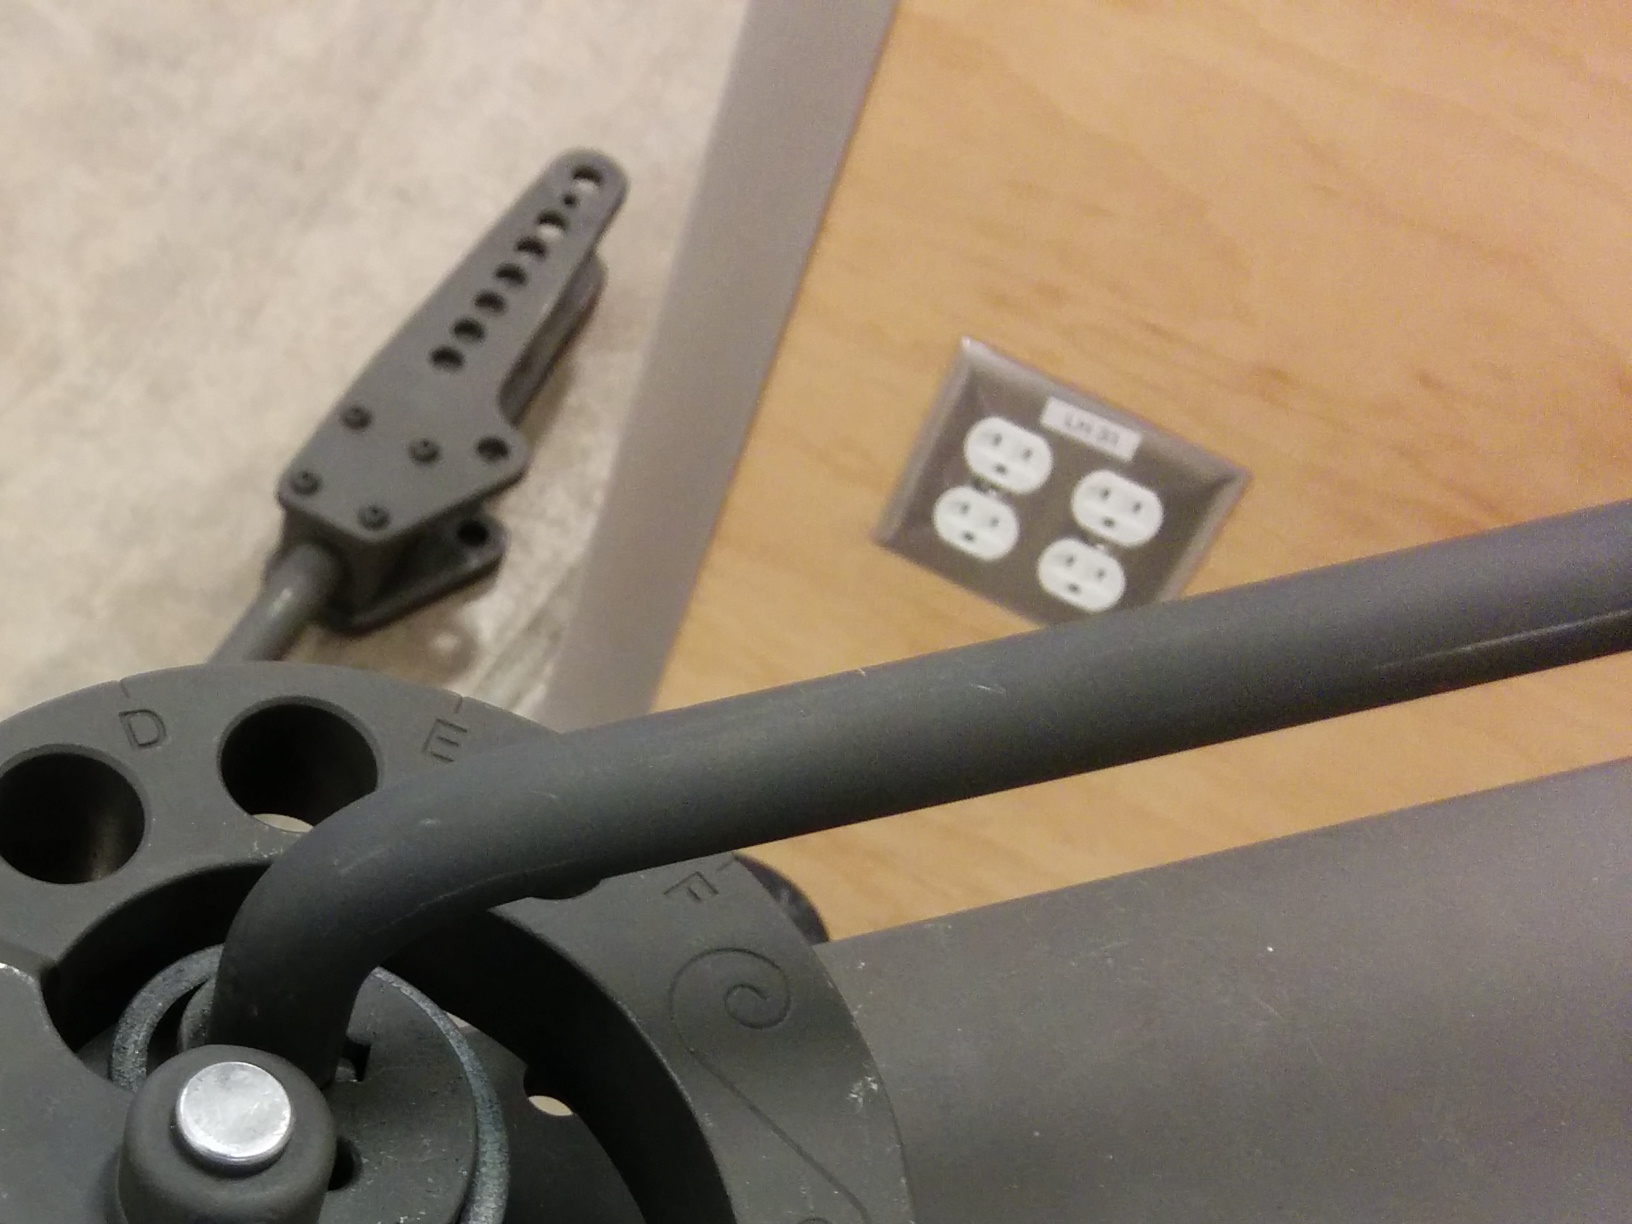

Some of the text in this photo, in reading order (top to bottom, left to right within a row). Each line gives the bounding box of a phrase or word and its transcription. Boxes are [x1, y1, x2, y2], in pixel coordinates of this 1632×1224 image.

[118, 707, 167, 751] D
[421, 717, 469, 764] E
[662, 870, 720, 902] F
